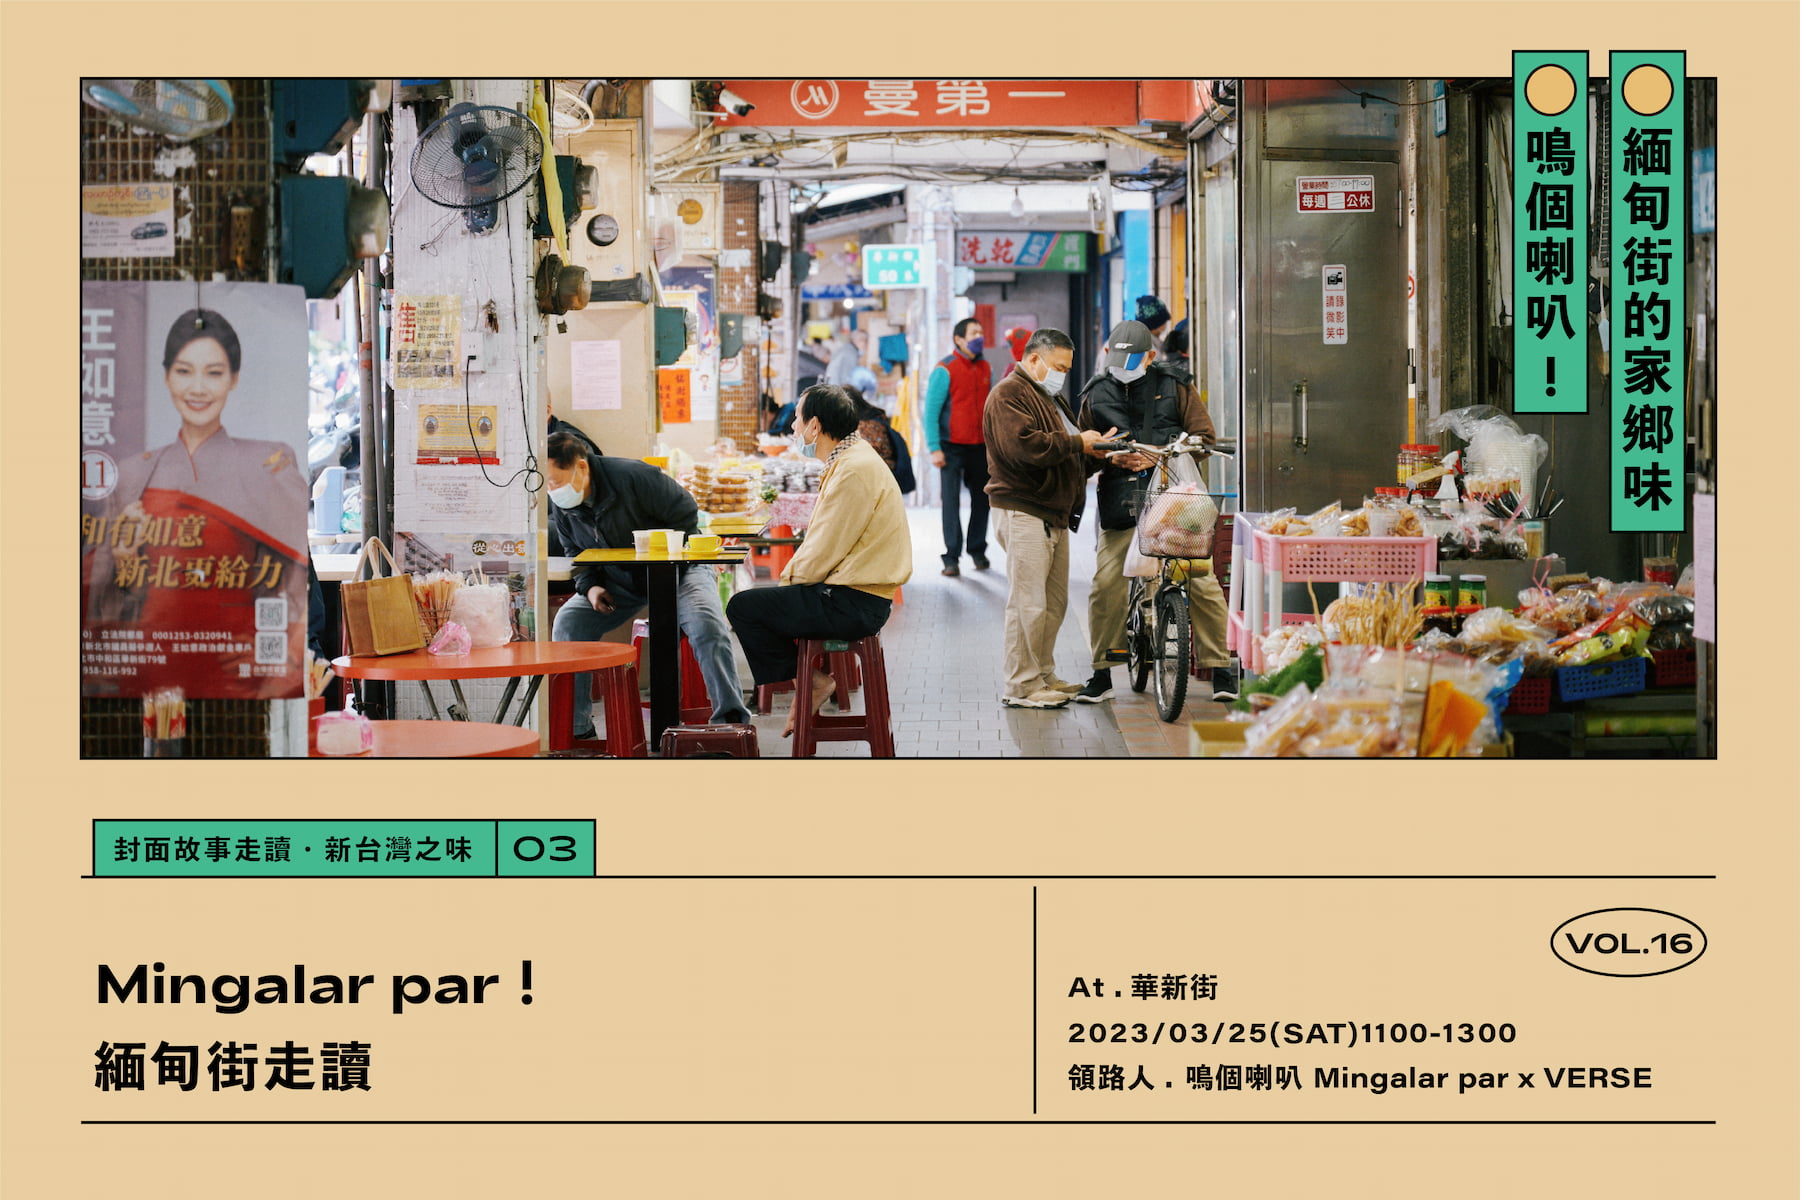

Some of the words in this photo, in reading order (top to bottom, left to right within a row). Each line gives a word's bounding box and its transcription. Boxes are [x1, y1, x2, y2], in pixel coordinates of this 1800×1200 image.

[1302, 194, 1326, 208] 每週
[1347, 193, 1370, 207] 公休
[1326, 296, 1335, 340] 請微笑
[1336, 296, 1345, 340] 錄影中
[82, 308, 116, 446] 王如意
[82, 460, 110, 488] 11
[114, 555, 283, 590] 新北更給力
